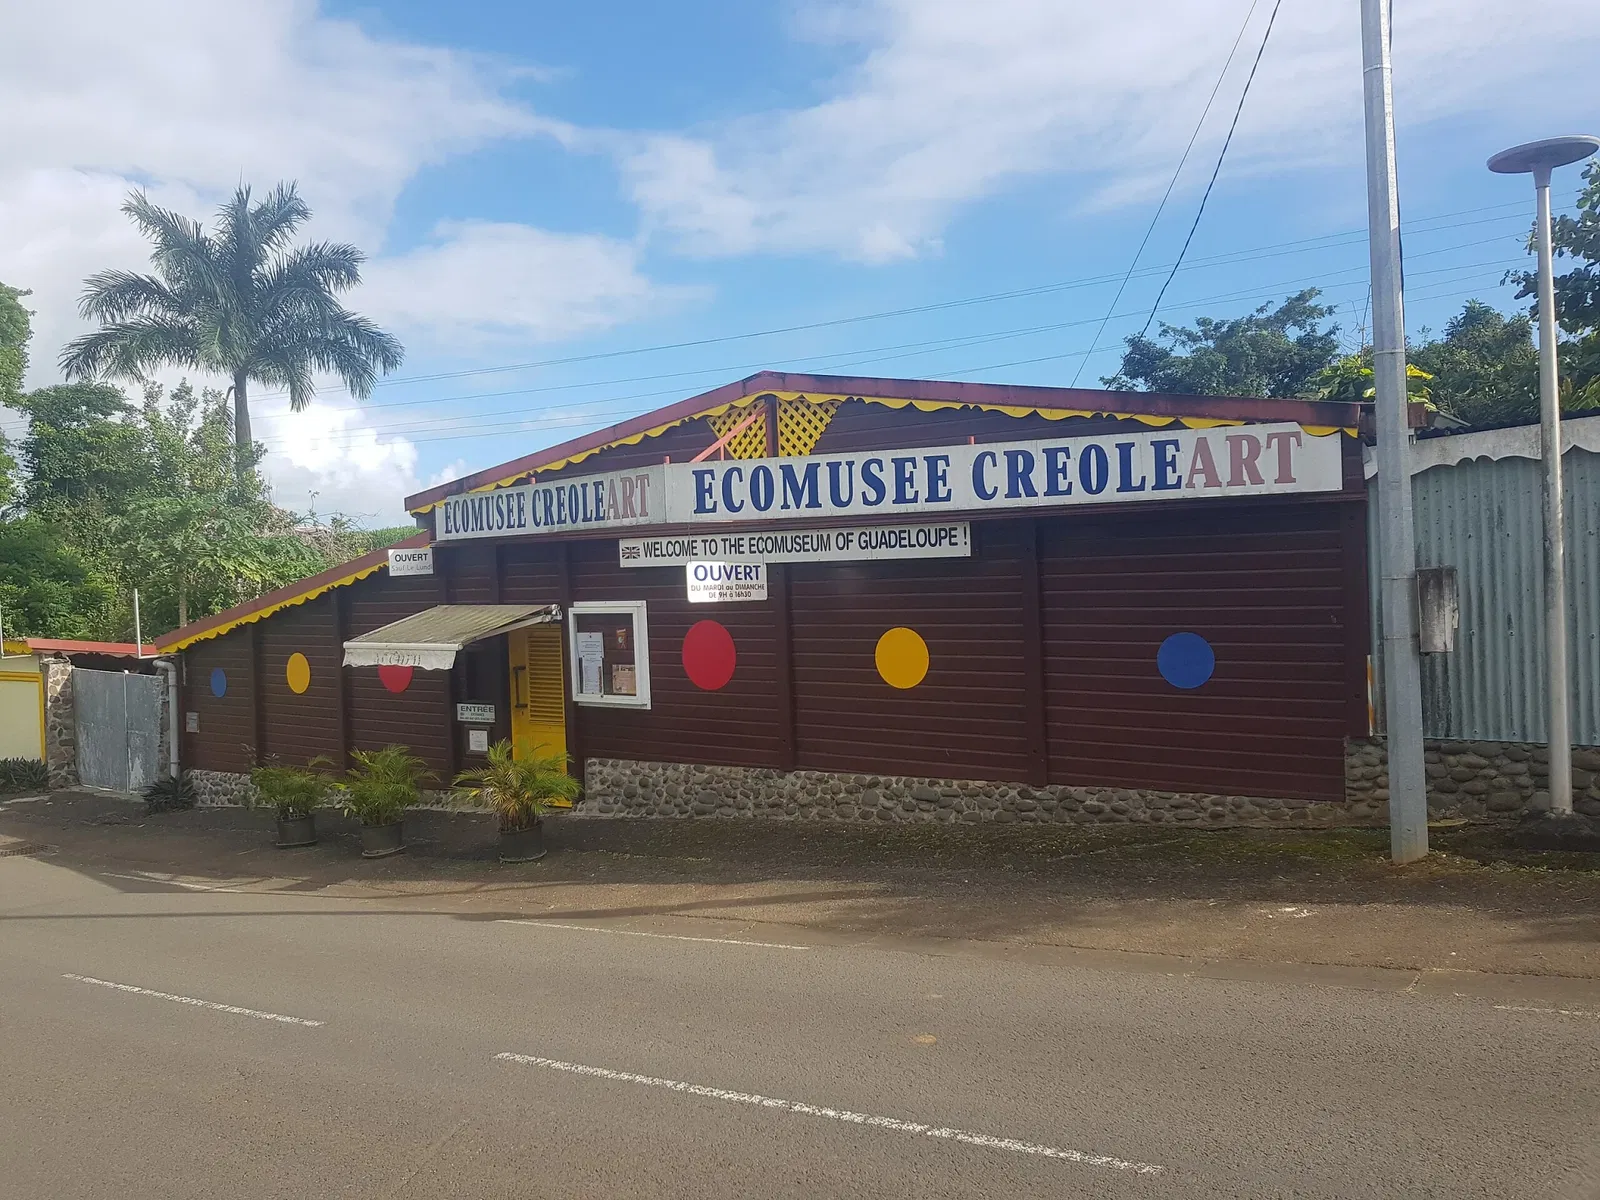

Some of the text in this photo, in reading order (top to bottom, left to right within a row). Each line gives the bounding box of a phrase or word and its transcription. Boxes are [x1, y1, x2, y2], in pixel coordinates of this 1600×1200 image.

[692, 454, 952, 514] ECOMUSEE
[444, 493, 527, 534] ECOMUSEE
[643, 539, 698, 559] WELCOME
[701, 538, 718, 556] TO
[721, 537, 745, 555] THE
[750, 533, 831, 554] ECOMUSEUM
[835, 531, 854, 551] OF
[858, 527, 959, 550] GUADELOUPE
[394, 553, 428, 562] OUVERT
[694, 564, 761, 582] OUVERT
[690, 584, 701, 592] DU
[703, 583, 724, 592] MARDI
[735, 583, 765, 591] DIMANCHE
[708, 591, 717, 599] DE
